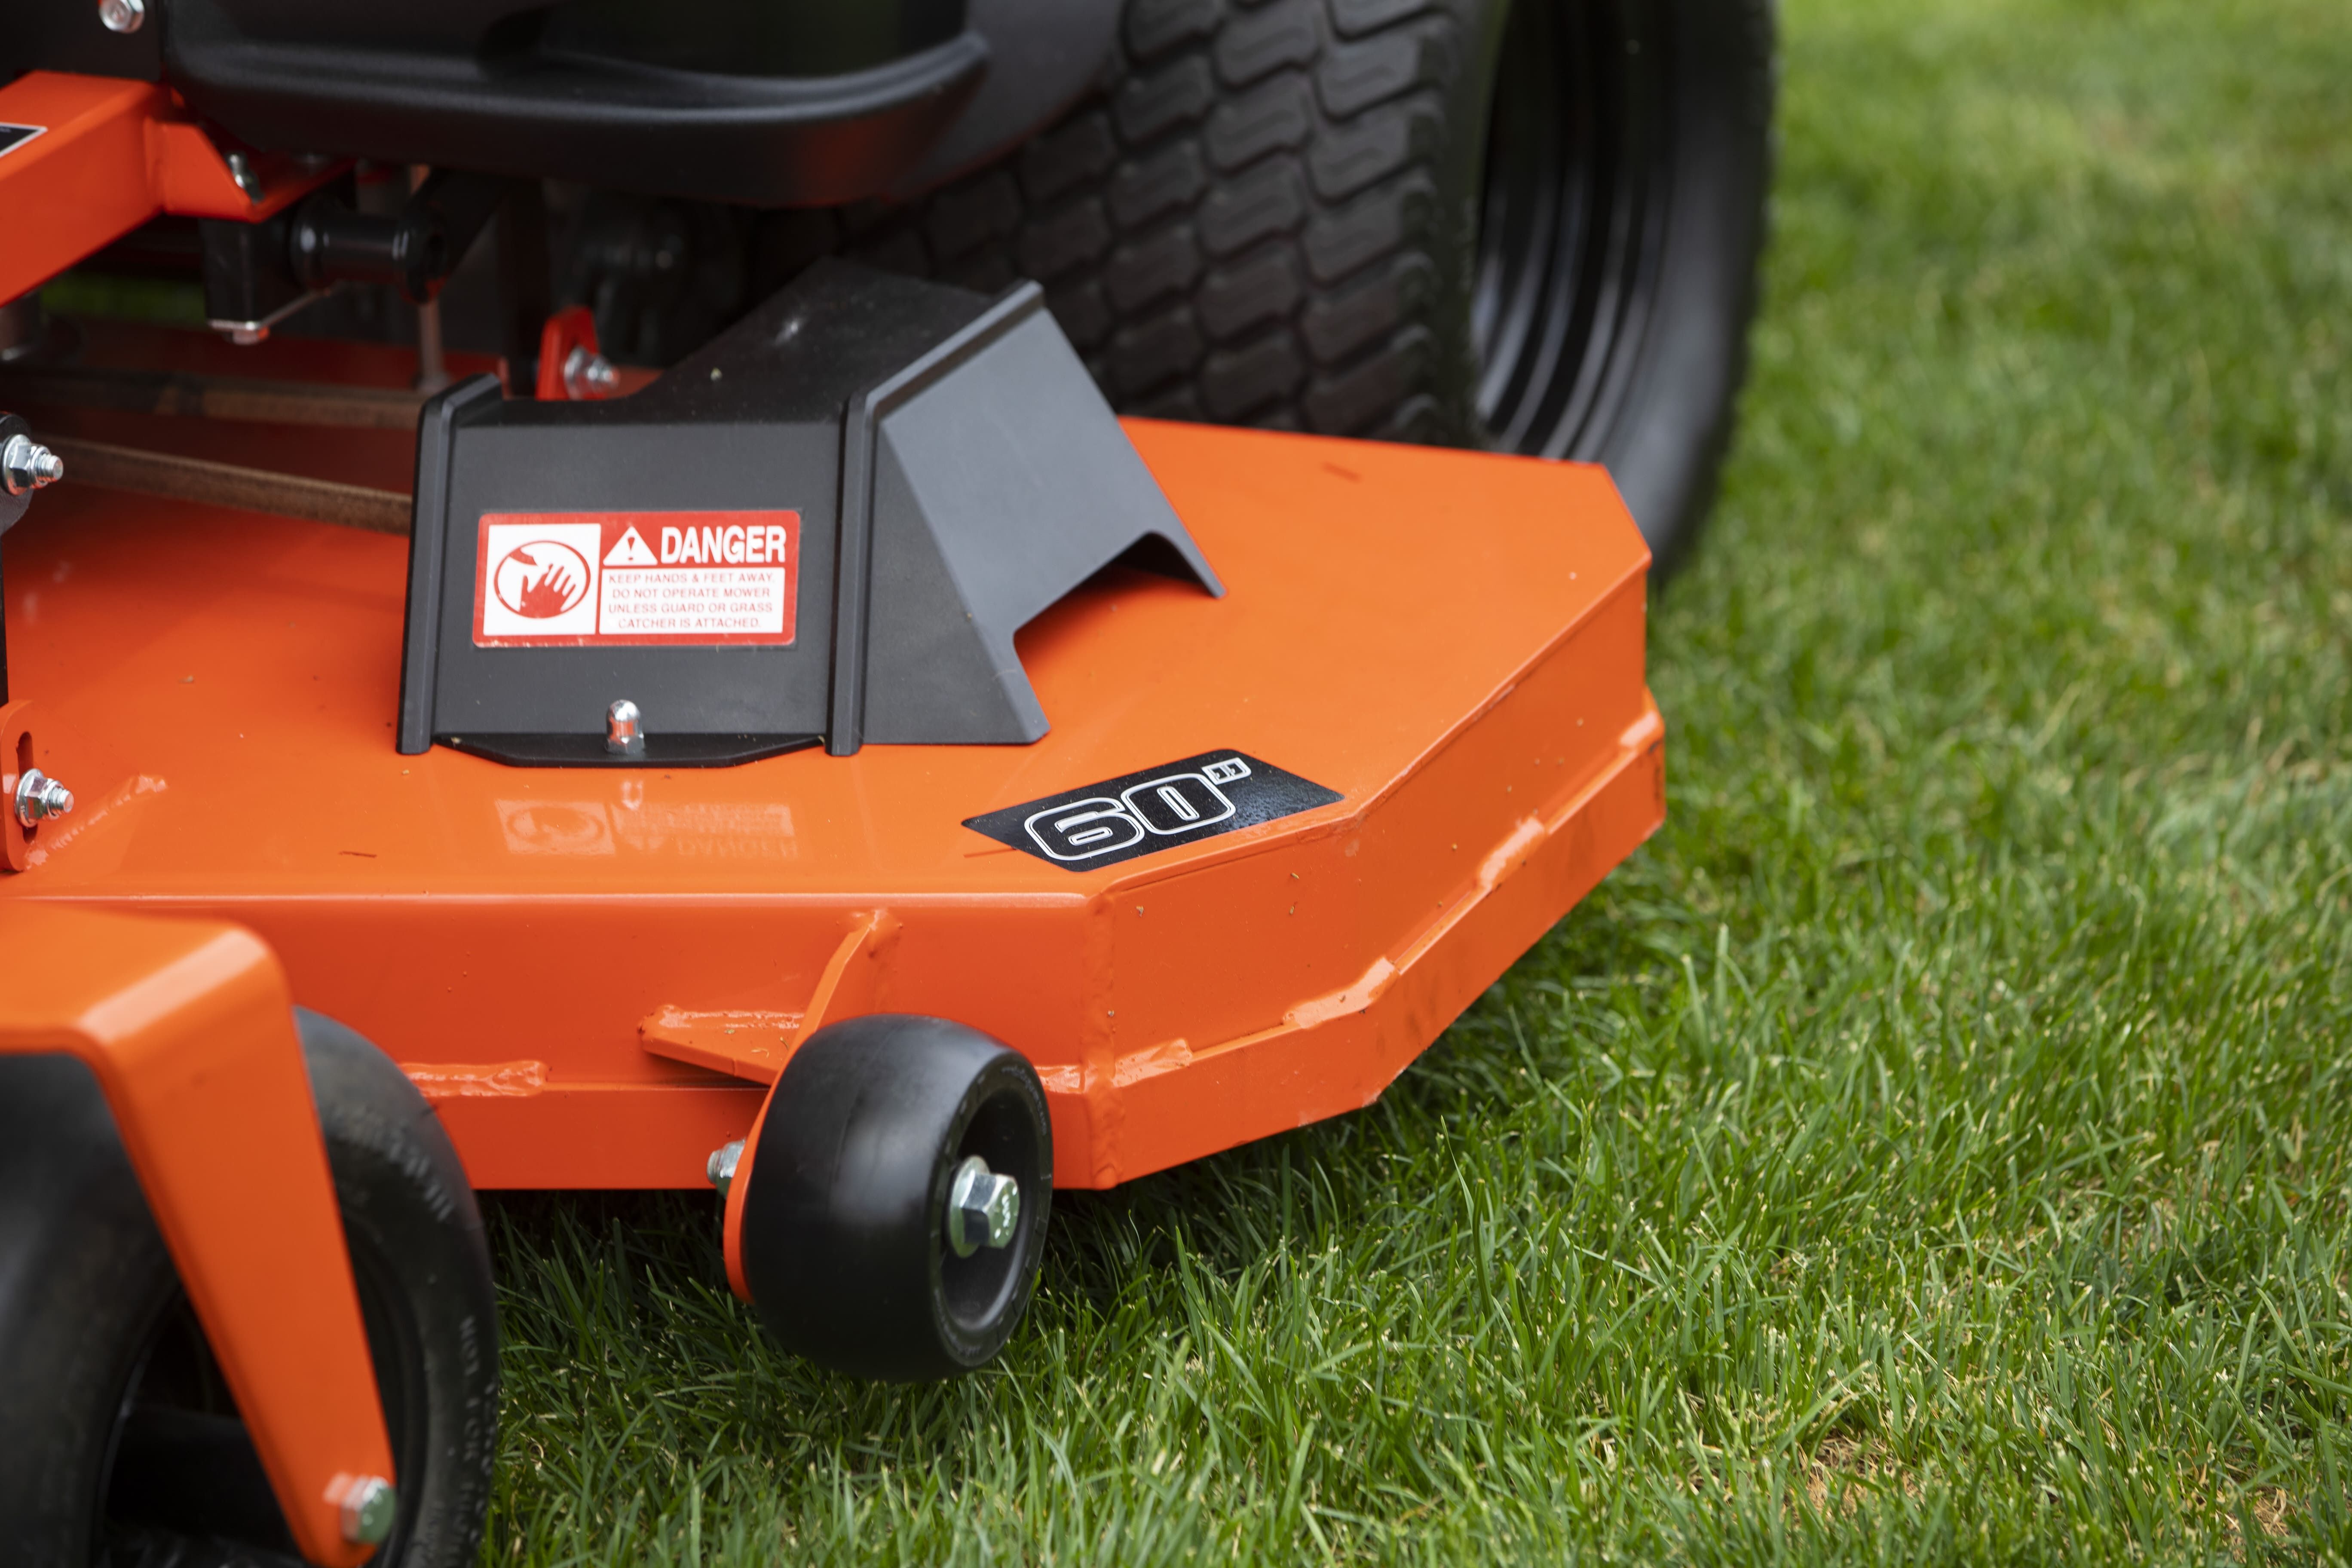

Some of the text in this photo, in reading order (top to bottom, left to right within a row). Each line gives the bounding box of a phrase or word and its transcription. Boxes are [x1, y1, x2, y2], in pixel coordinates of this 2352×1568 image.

[661, 525, 787, 564] DANGER
[609, 574, 641, 584] KEEP
[646, 573, 687, 584] HANDS
[692, 573, 699, 583] &
[704, 573, 732, 583] FEET
[612, 587, 770, 599] DO NOT OPERATE MOWER
[609, 602, 772, 613] UNLESS GUARD OR GRASS
[619, 618, 761, 628] CATCHER IS ATTACHED.
